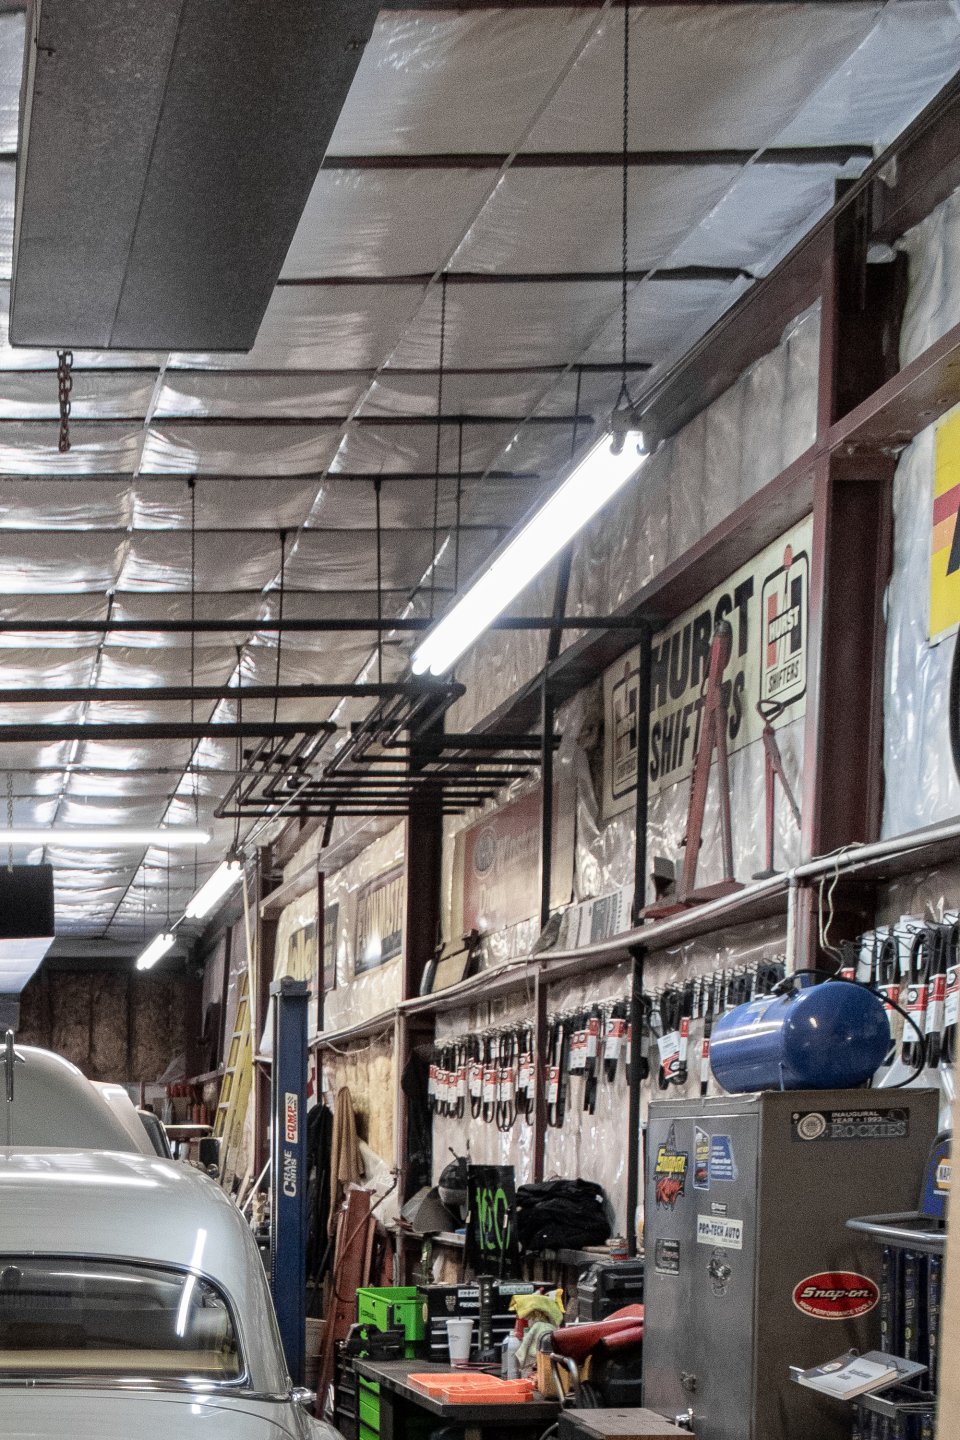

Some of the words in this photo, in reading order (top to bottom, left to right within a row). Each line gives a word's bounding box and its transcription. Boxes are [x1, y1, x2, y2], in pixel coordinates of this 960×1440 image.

[768, 605, 800, 643] HURST
[768, 660, 799, 693] SHIFTERS
[650, 670, 745, 782] SHIFTS
[286, 1105, 296, 1141] COMP
[831, 1121, 907, 1138] ROCKIES
[725, 1227, 740, 1240] AUTO
[800, 1286, 870, 1300] Snap-on
[799, 1301, 812, 1311] HIGH
[812, 1307, 854, 1317] PERFORMANCE
[855, 1301, 873, 1313] TOOLS
